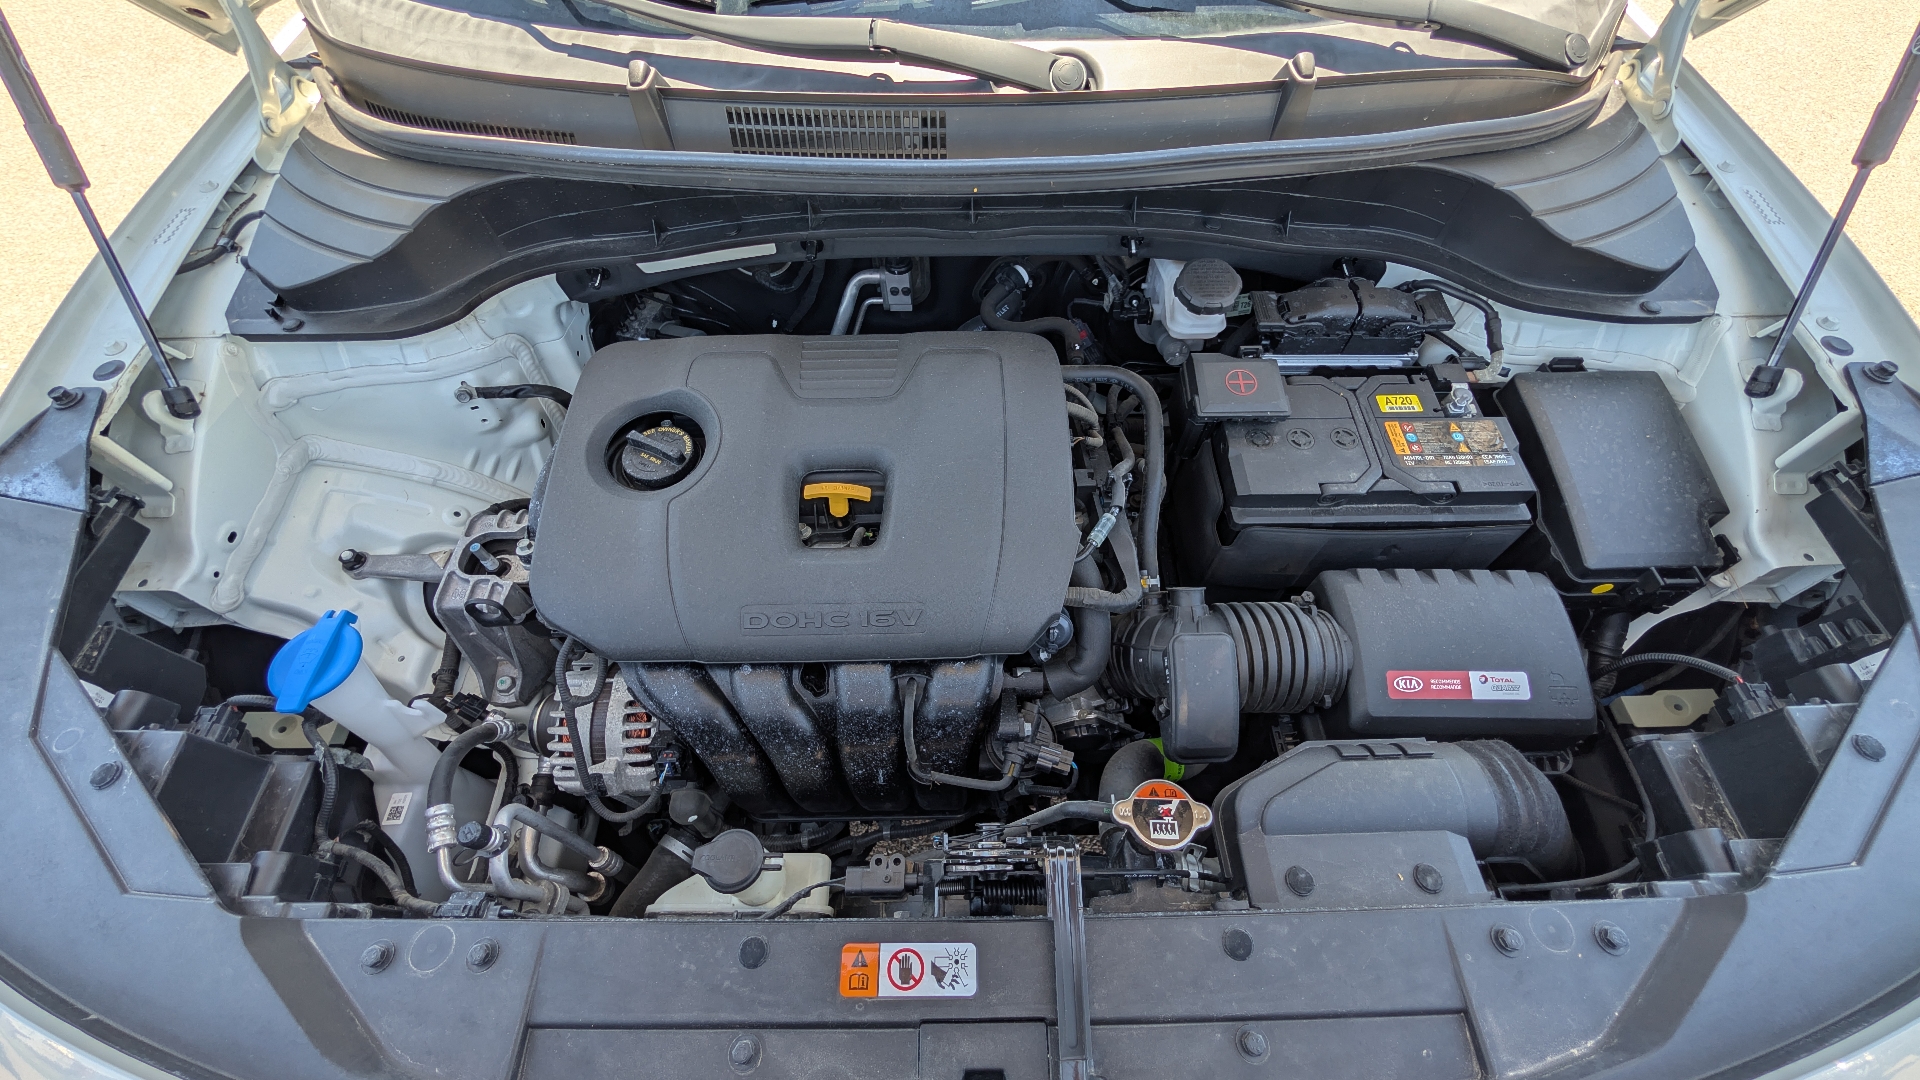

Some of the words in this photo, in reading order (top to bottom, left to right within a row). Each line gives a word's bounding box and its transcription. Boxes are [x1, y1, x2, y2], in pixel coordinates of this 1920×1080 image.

[1385, 396, 1413, 406] A720
[743, 611, 849, 629] DOHC
[860, 609, 923, 627] 16V
[1398, 679, 1419, 689] KIA
[699, 854, 736, 862] COOLANT
